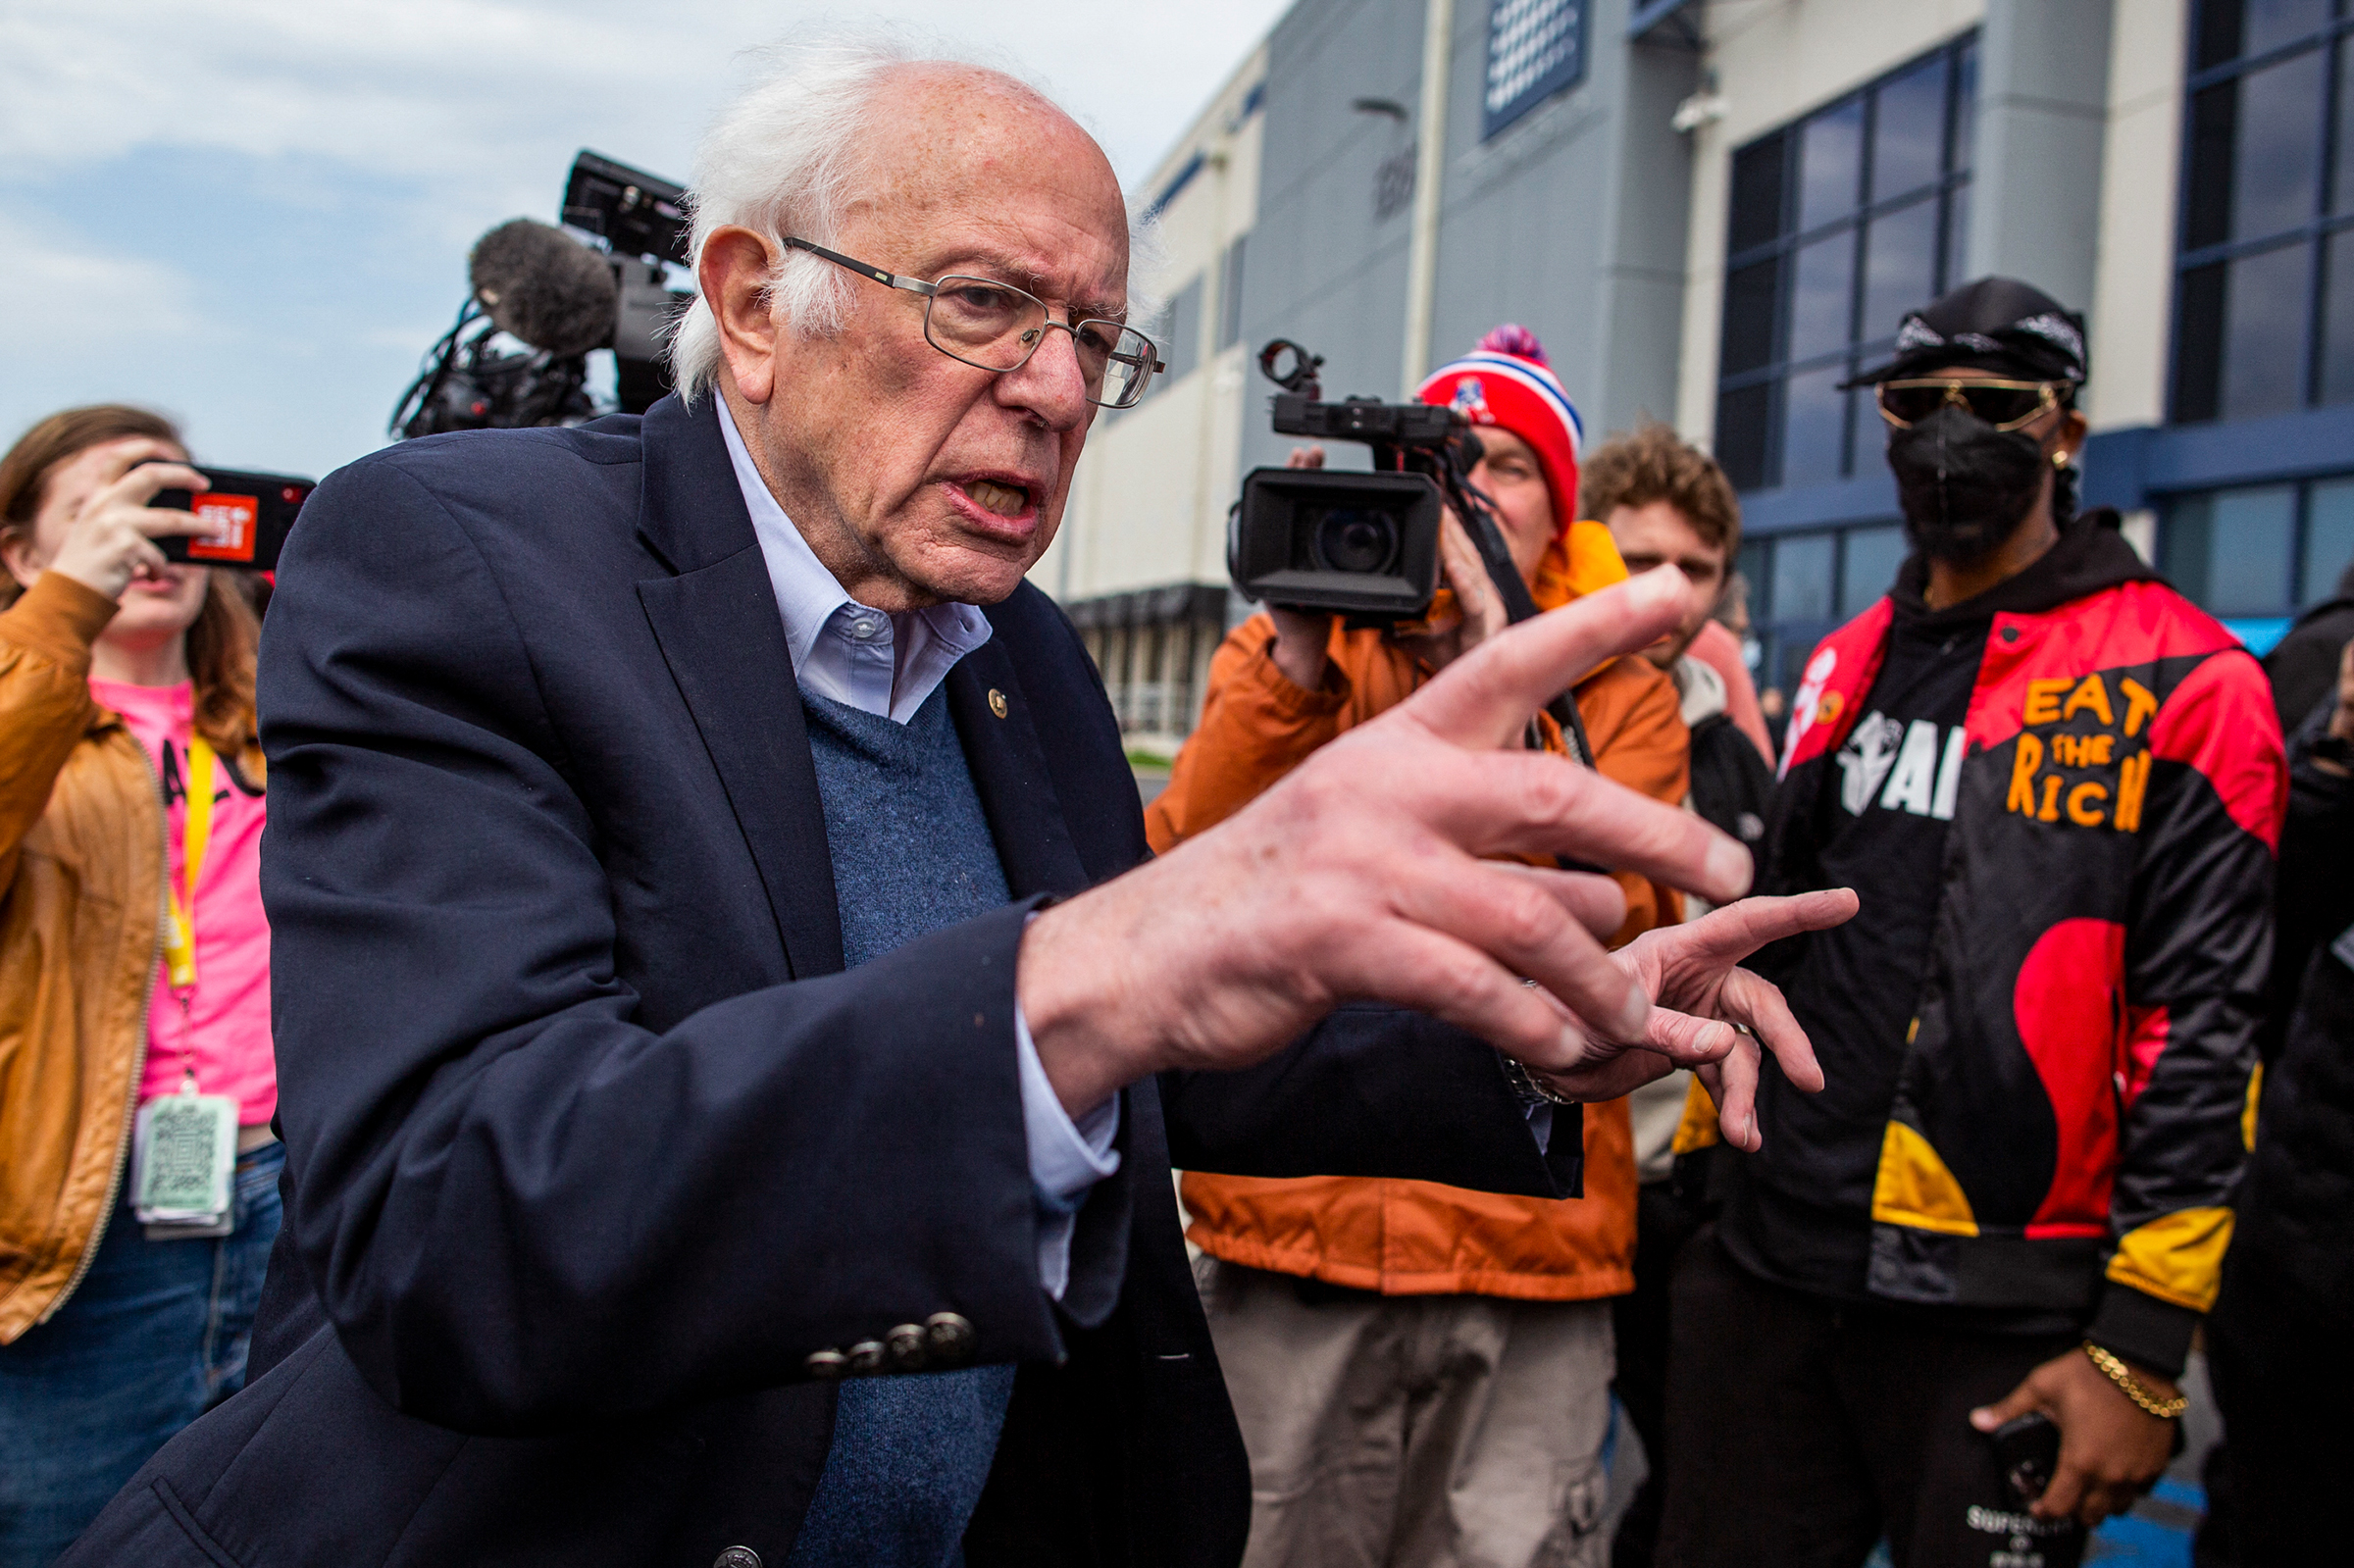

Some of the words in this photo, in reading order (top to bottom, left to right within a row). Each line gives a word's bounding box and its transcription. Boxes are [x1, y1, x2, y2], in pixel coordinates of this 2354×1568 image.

[2022, 672, 2159, 737] EAT
[2007, 732, 2153, 833] RICH
[2050, 733, 2116, 768] THE
